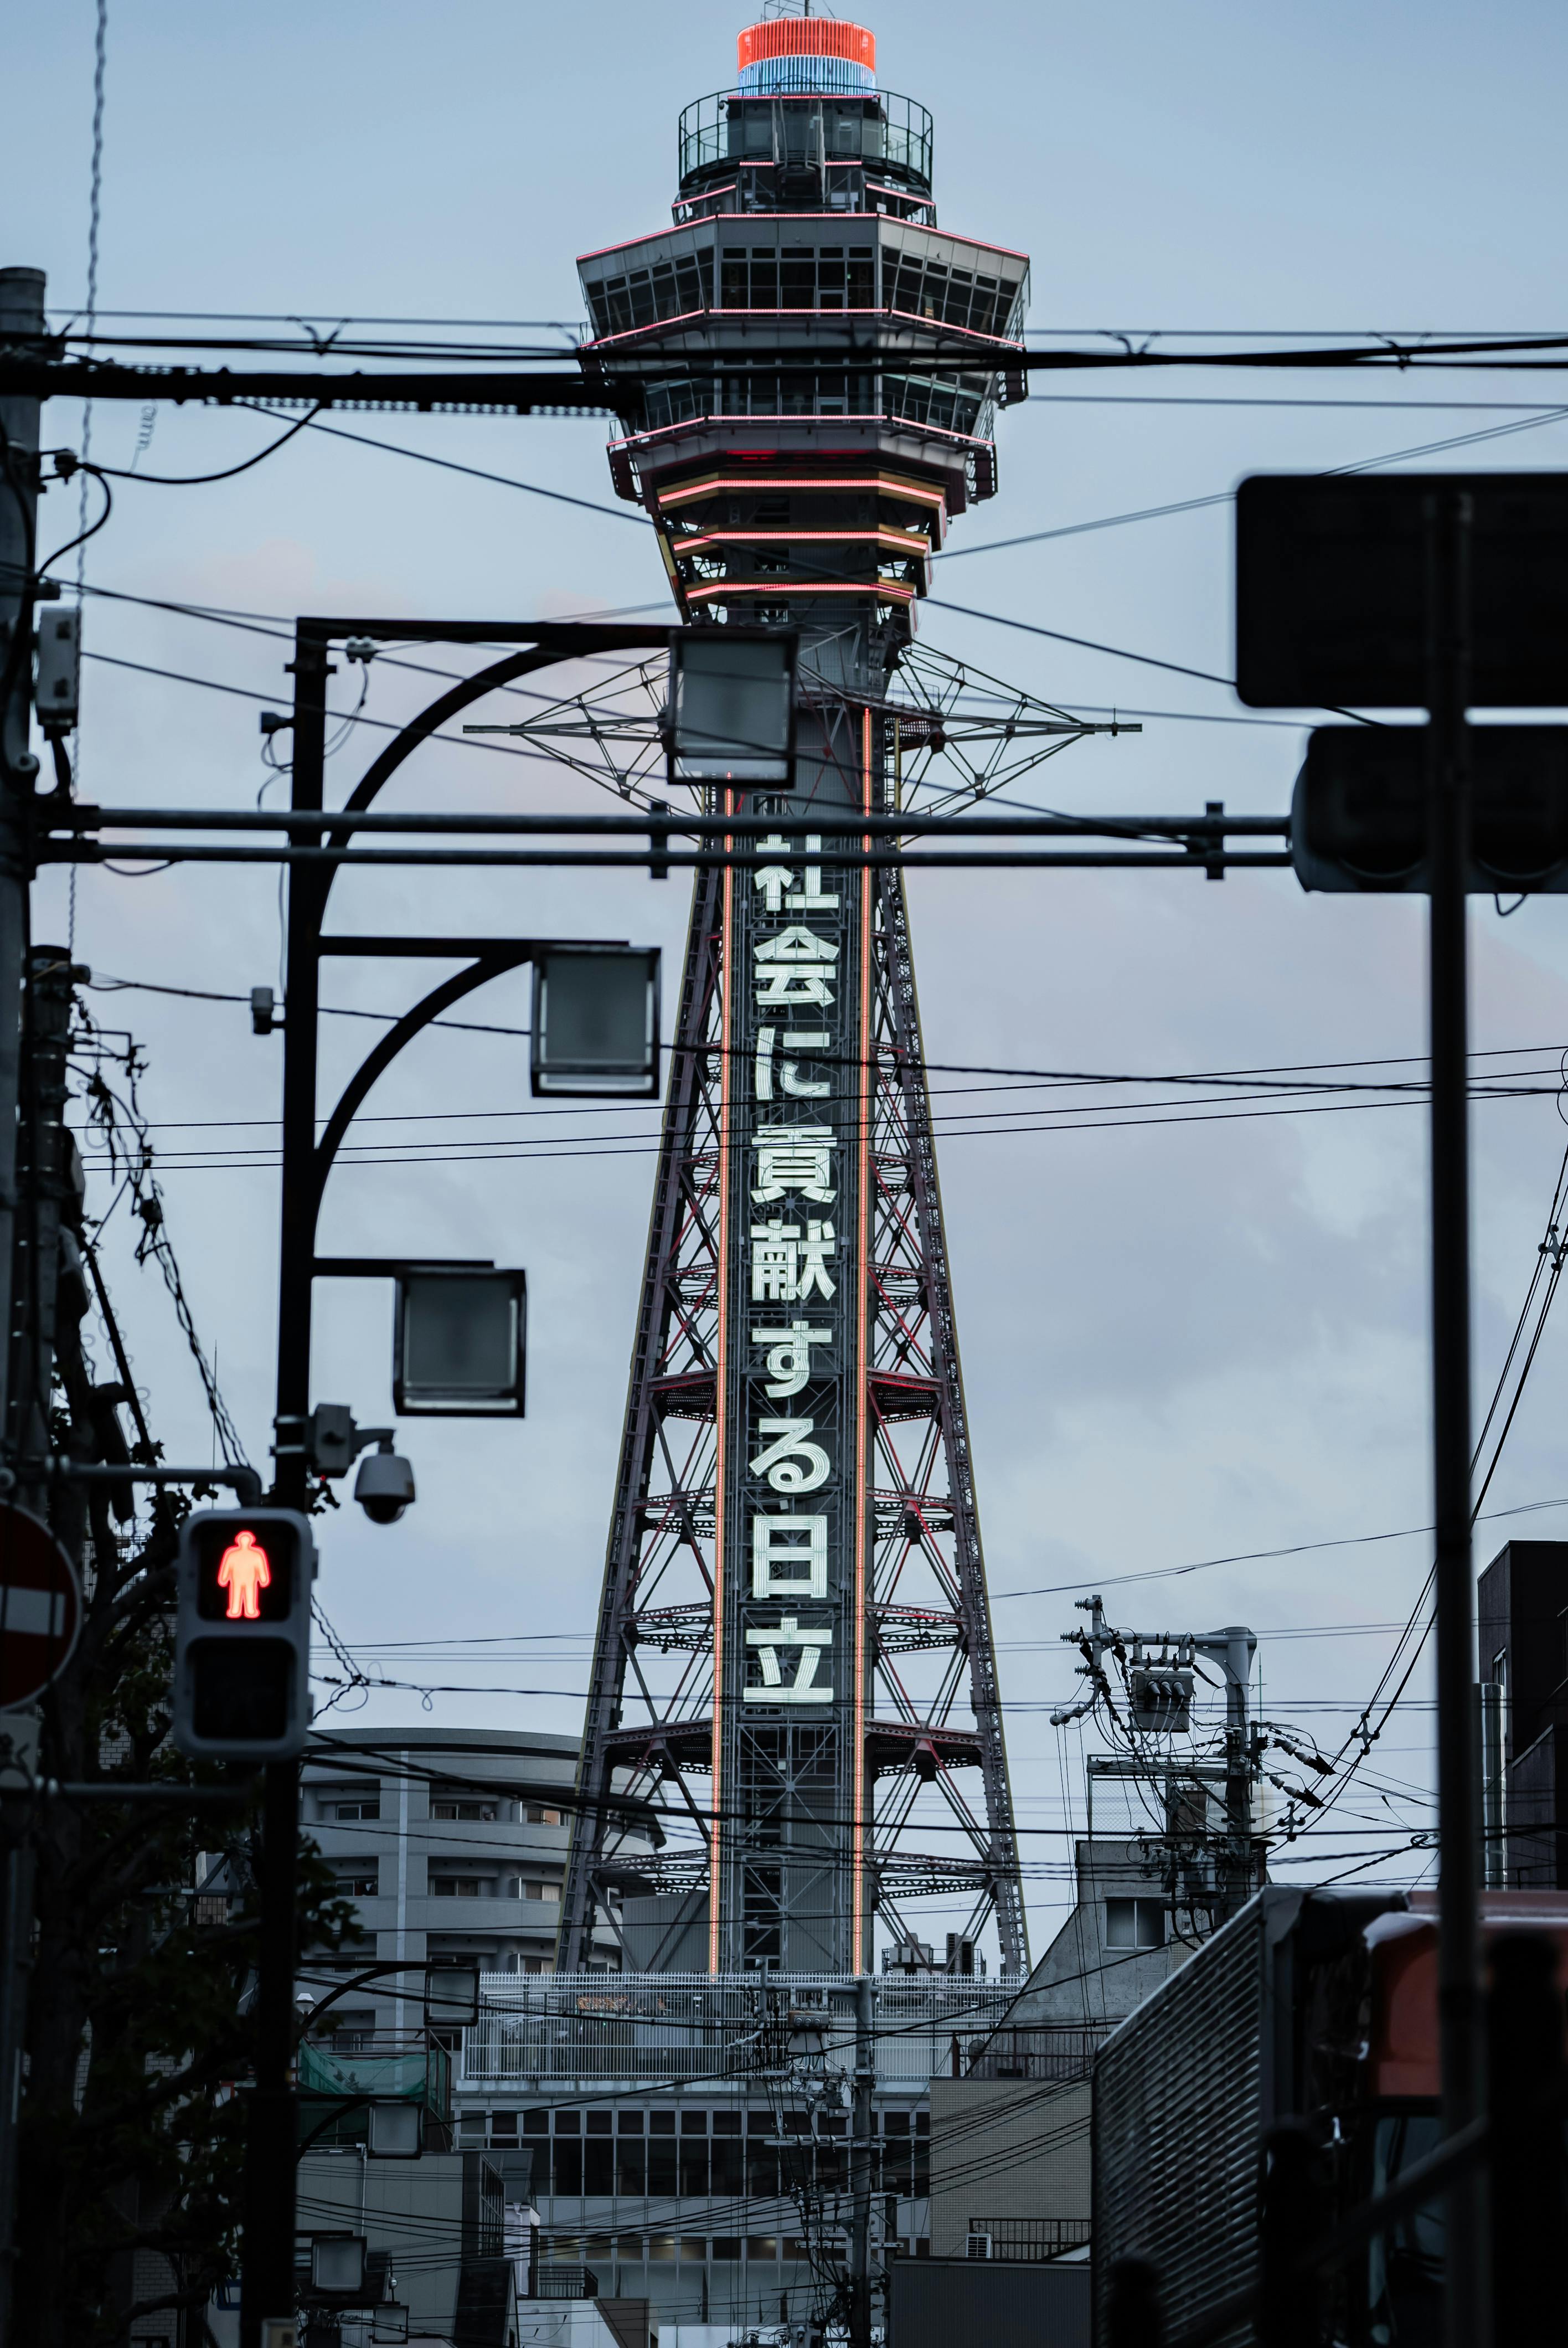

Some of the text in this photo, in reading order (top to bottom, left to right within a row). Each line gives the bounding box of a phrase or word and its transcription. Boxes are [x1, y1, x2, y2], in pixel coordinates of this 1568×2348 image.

[743, 835, 839, 1702] 社会に貢献する日立
